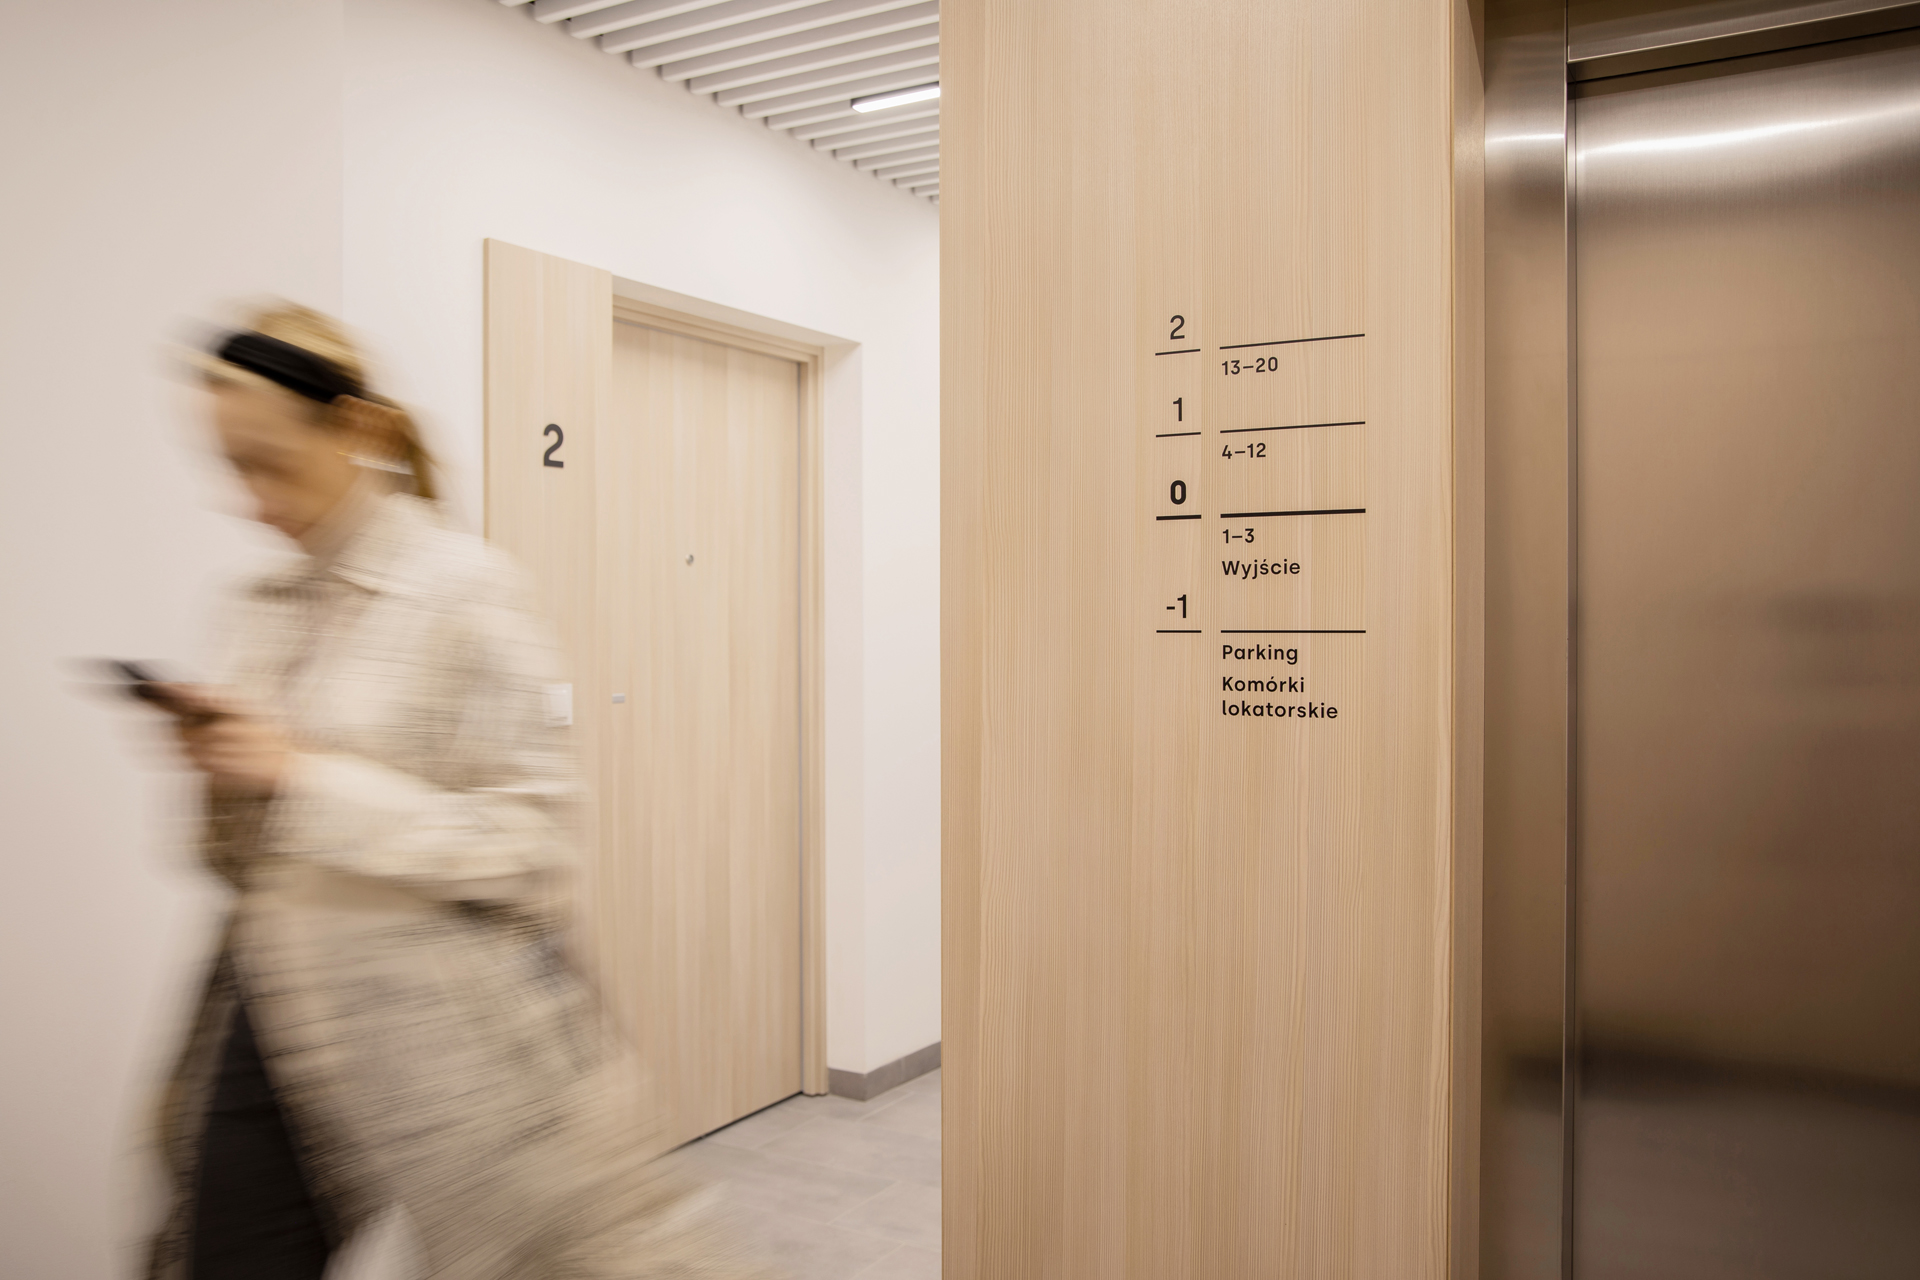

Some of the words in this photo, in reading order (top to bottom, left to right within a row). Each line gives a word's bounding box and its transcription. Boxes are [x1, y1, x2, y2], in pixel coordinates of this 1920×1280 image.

[1170, 314, 1186, 340] 2
[1172, 397, 1183, 422] 1
[543, 423, 564, 469] 2
[1170, 479, 1187, 505] 0
[1221, 558, 1301, 580] Wyjście
[1166, 594, 1187, 619] -1
[1222, 643, 1299, 666] Parking
[1222, 675, 1305, 693] Komórki
[1222, 699, 1339, 719] lokatorskie
